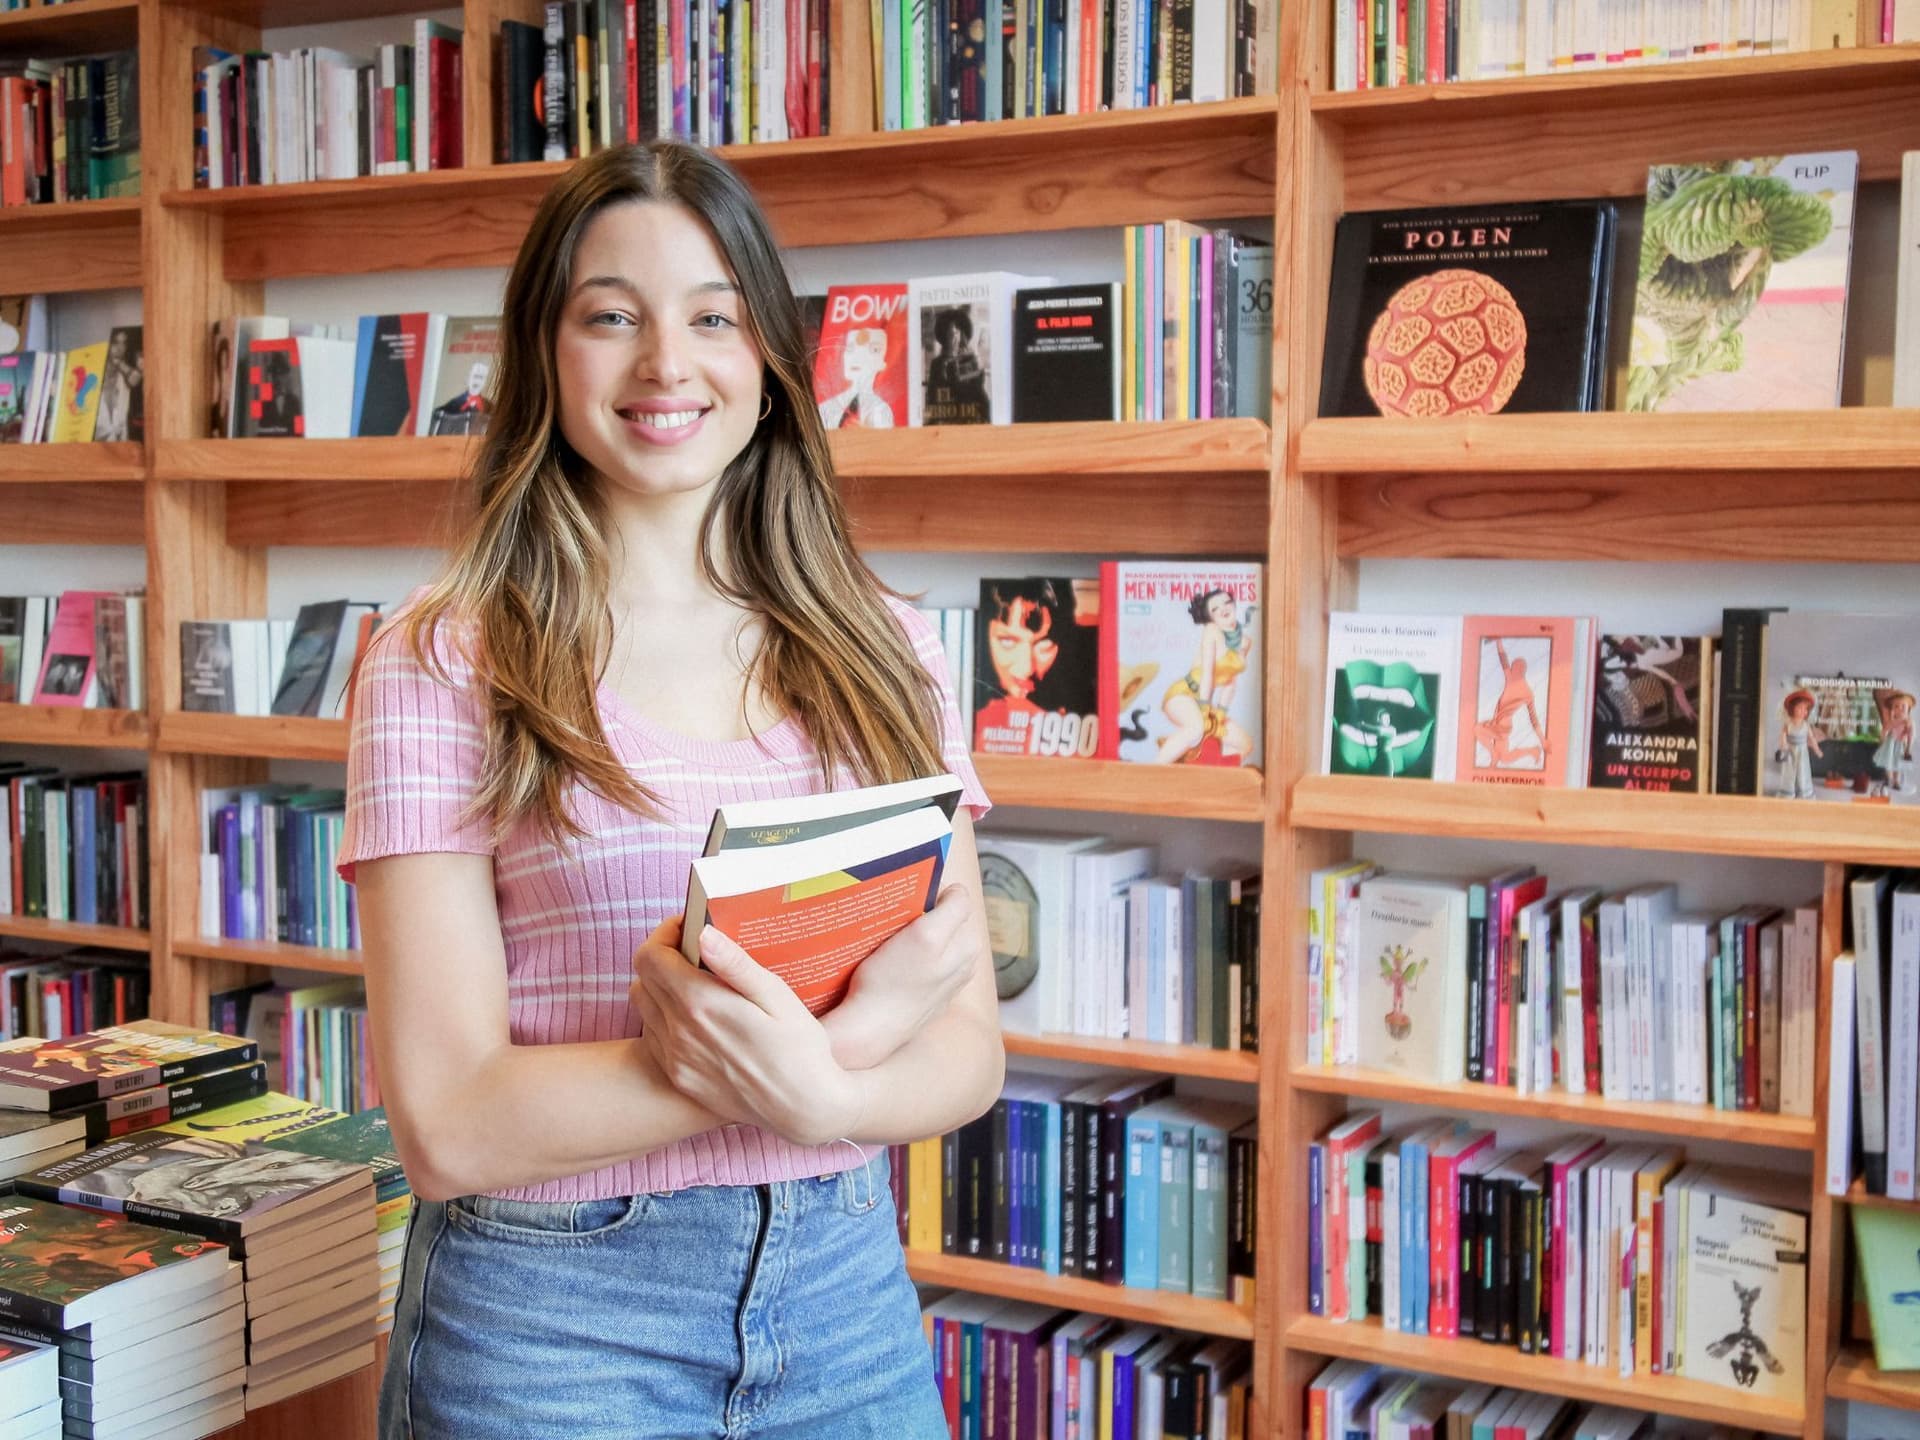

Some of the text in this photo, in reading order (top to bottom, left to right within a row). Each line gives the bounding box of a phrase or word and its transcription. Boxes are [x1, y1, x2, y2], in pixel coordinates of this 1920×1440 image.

[1117, 25, 1129, 94] MUNDOS
[1183, 33, 1192, 85] WALTER
[1794, 165, 1830, 180] FLIP
[1405, 227, 1512, 249] POLEN
[1368, 248, 1548, 264] LA SEXUALIDAD OCULTA DE LAS FLORES
[919, 284, 990, 302] PATTI SMITH
[1125, 581, 1168, 600] MEN'S
[1344, 623, 1437, 637] Simone de Beauvoir
[1029, 710, 1099, 758] 1990
[1606, 733, 1697, 751] ALEXANDRA
[1621, 747, 1678, 763] KOHAN
[1607, 765, 1691, 780] UN CUERPO
[1624, 780, 1670, 793] AL FIN
[37, 1141, 136, 1179] SELVA ALMADA
[75, 1157, 112, 1175] viento
[112, 1149, 134, 1164] que
[134, 1136, 177, 1155] arrasa
[79, 1191, 103, 1207] ALMADA
[1065, 1201, 1075, 1253] Woody Allen
[1087, 1204, 1097, 1256] Woody Allen
